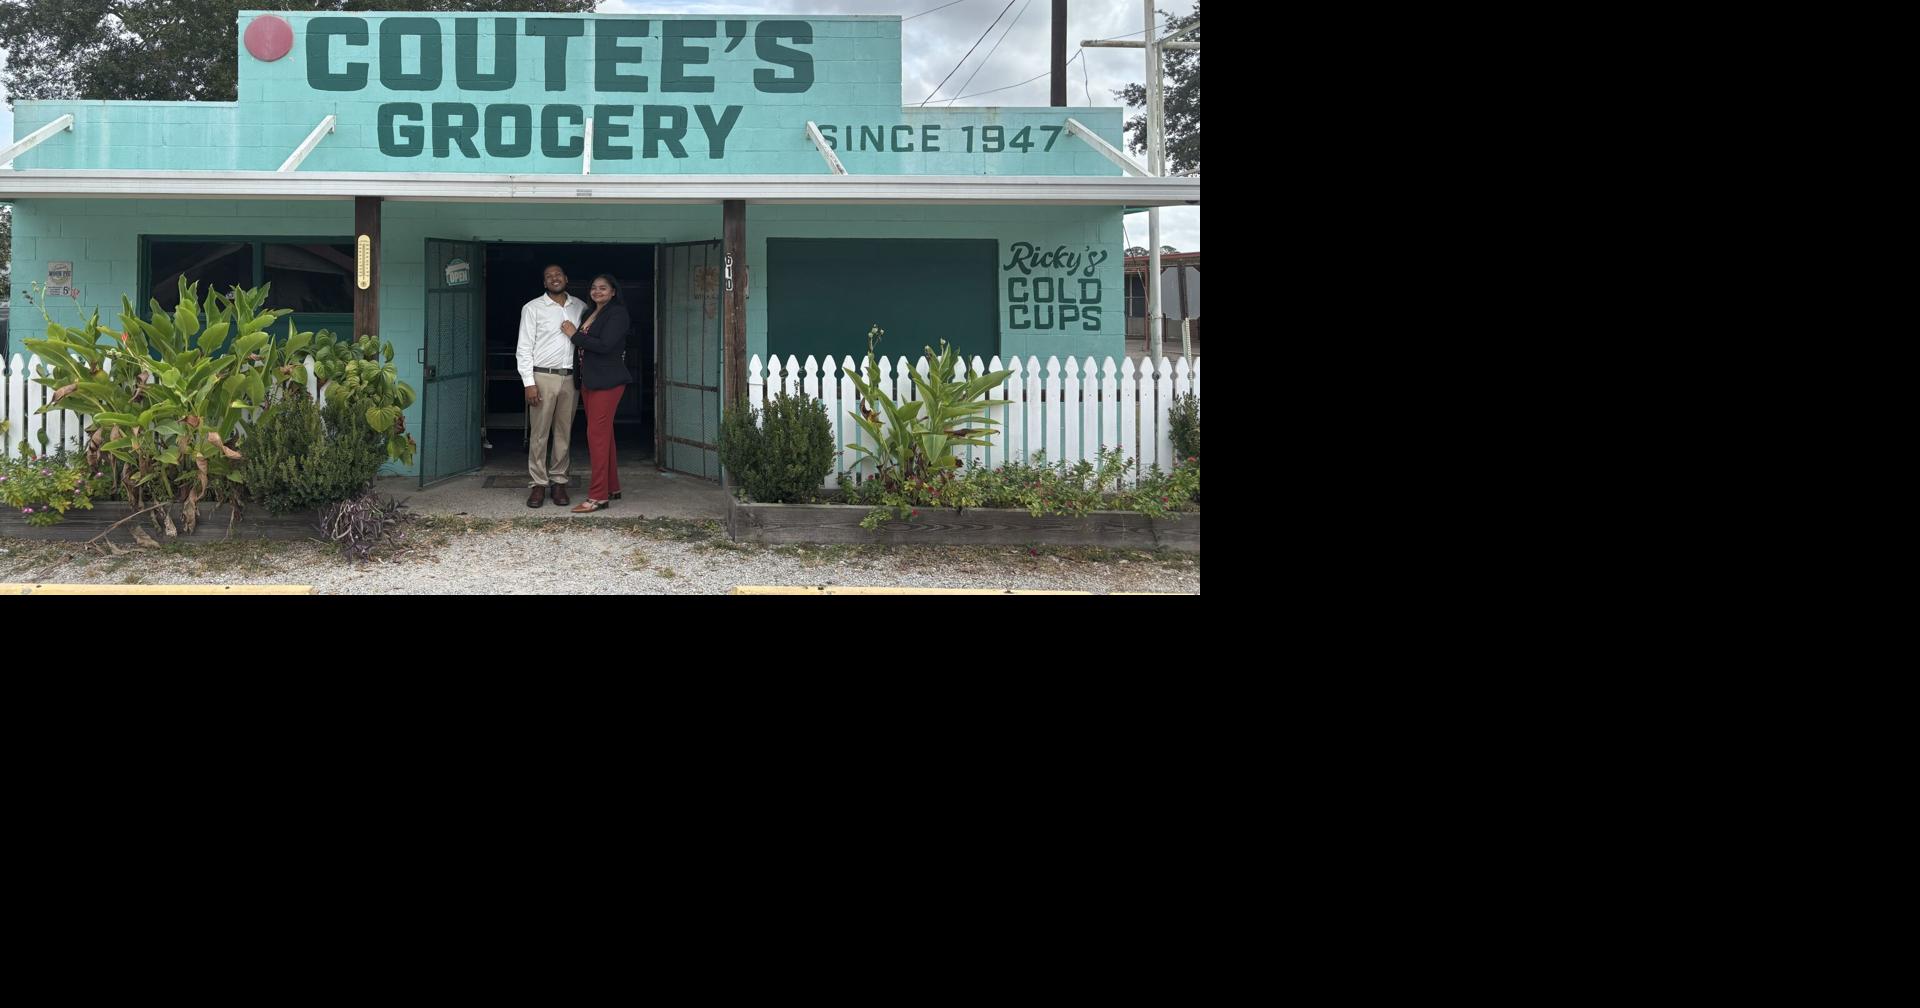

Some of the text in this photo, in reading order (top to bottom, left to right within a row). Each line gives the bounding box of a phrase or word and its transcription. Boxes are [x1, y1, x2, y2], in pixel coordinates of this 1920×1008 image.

[306, 17, 815, 94] COUTEE'S
[377, 102, 744, 160] GROCERY
[816, 124, 1064, 153] SINCE 1947
[1003, 241, 1108, 277] Ricky's
[1008, 277, 1102, 305] COLD
[1009, 304, 1102, 331] CUPS
